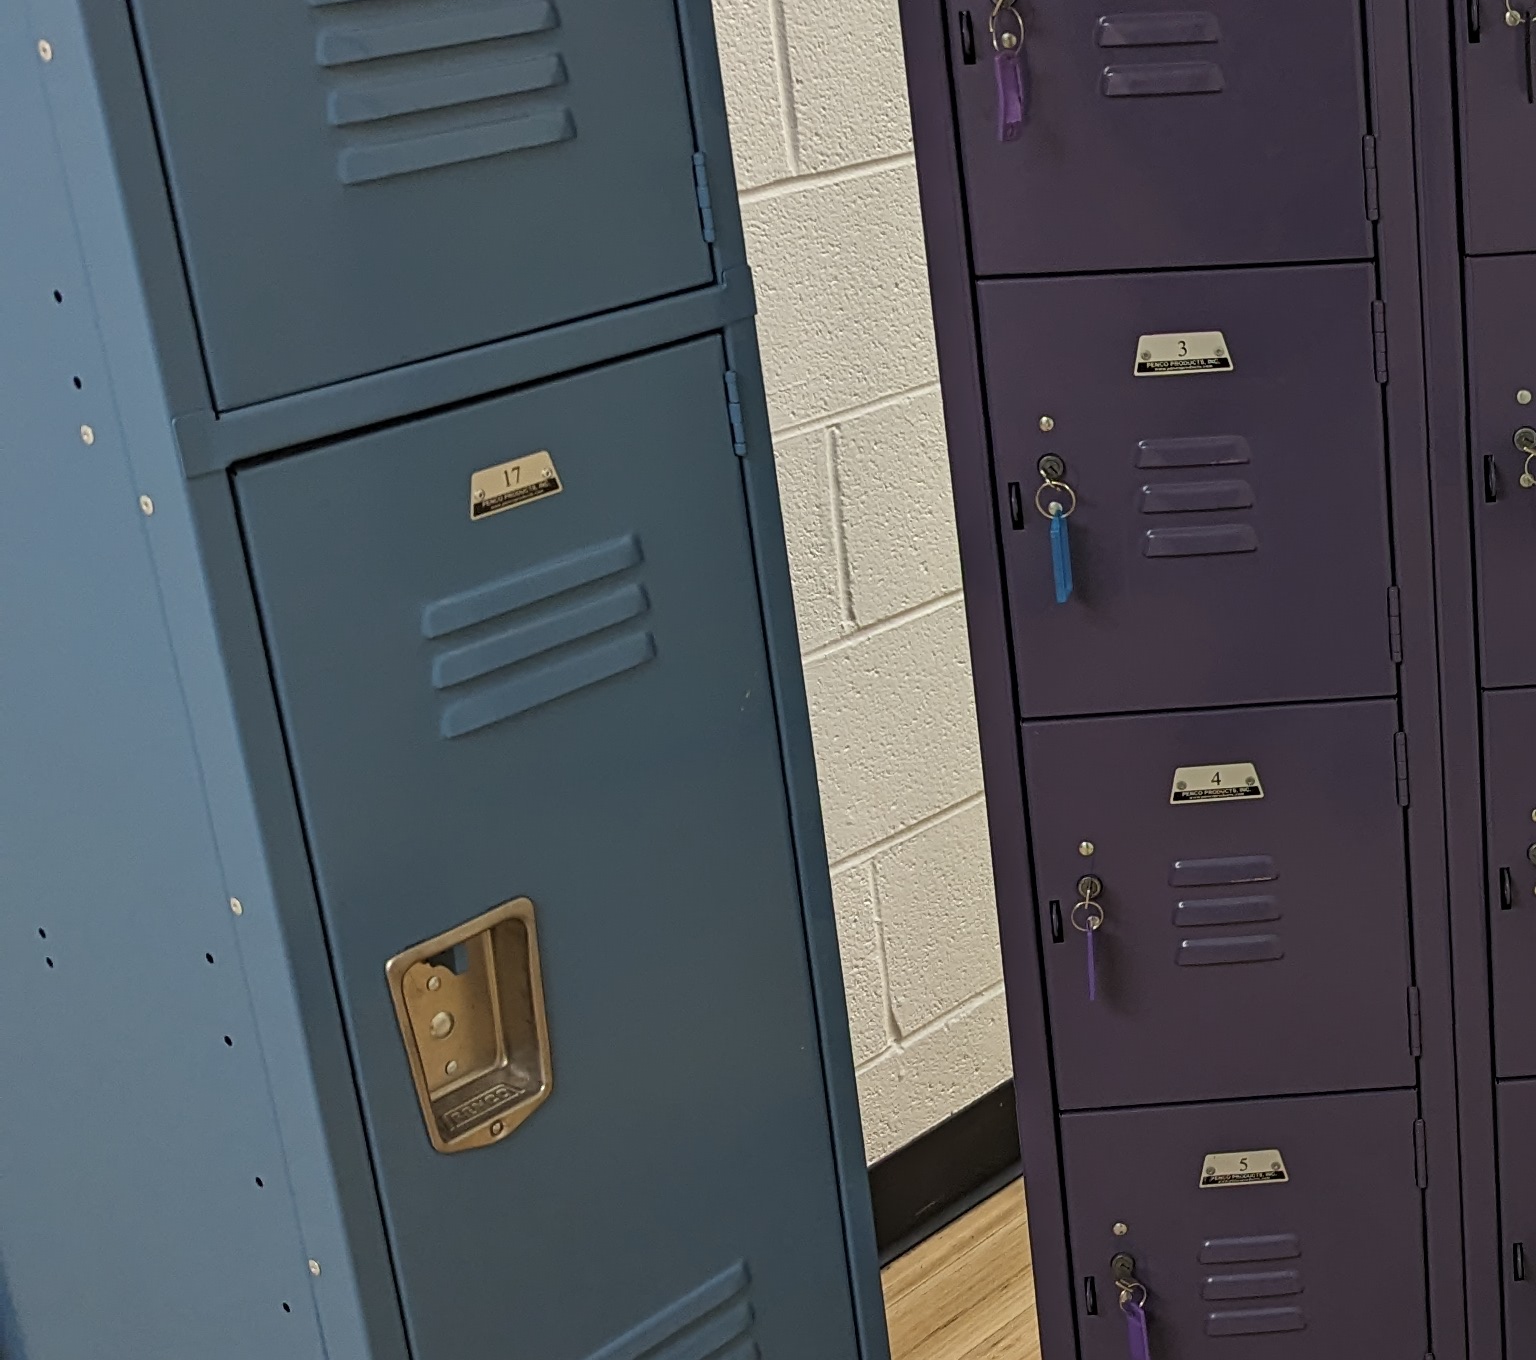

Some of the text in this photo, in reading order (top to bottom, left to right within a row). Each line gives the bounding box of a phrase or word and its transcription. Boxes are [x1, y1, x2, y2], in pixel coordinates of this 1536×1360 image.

[1178, 340, 1188, 357] 3
[504, 466, 520, 487] 17
[1211, 771, 1221, 786] 4
[1239, 1158, 1248, 1171] 5
